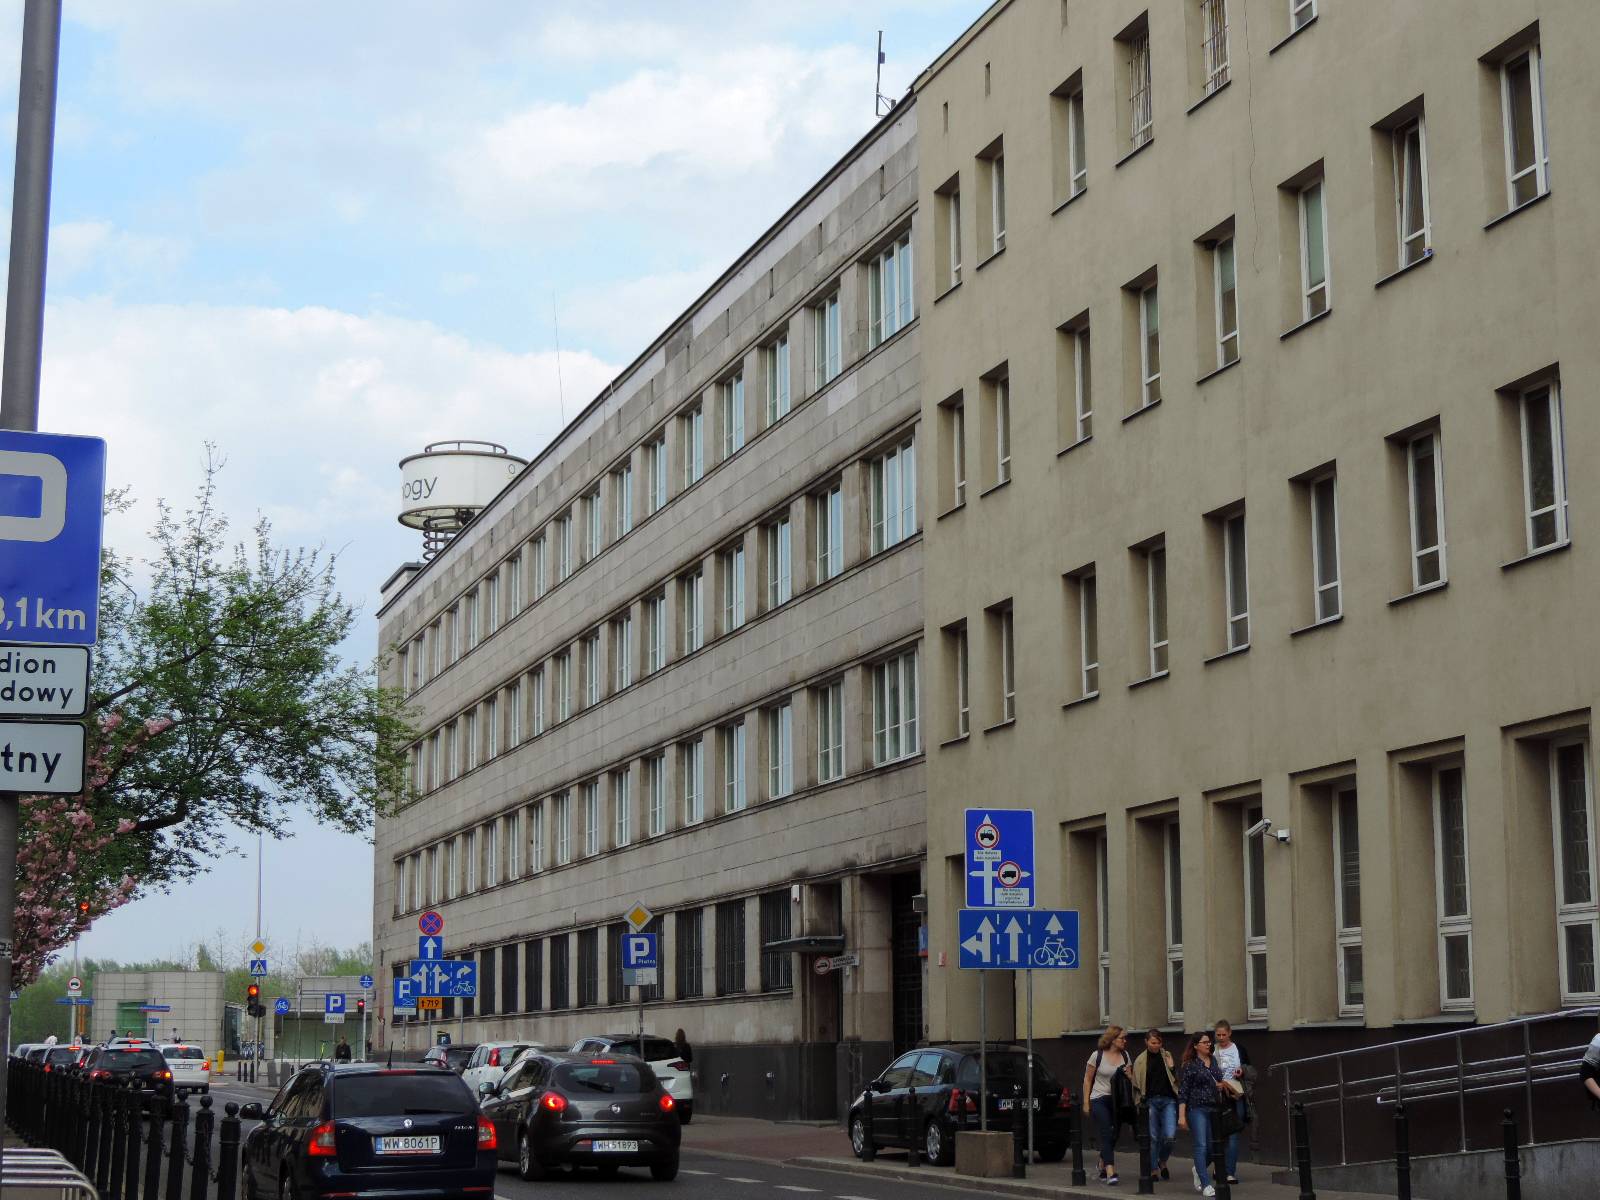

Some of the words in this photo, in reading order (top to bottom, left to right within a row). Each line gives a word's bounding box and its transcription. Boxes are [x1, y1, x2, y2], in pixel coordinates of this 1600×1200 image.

[36, 597, 86, 631] km
[0, 680, 74, 709] dowy
[0, 742, 62, 783] tny
[630, 937, 650, 965] P
[329, 995, 342, 1012] P
[427, 1000, 440, 1008] 719
[383, 1138, 400, 1149] WW
[403, 1137, 438, 1149] 8061P
